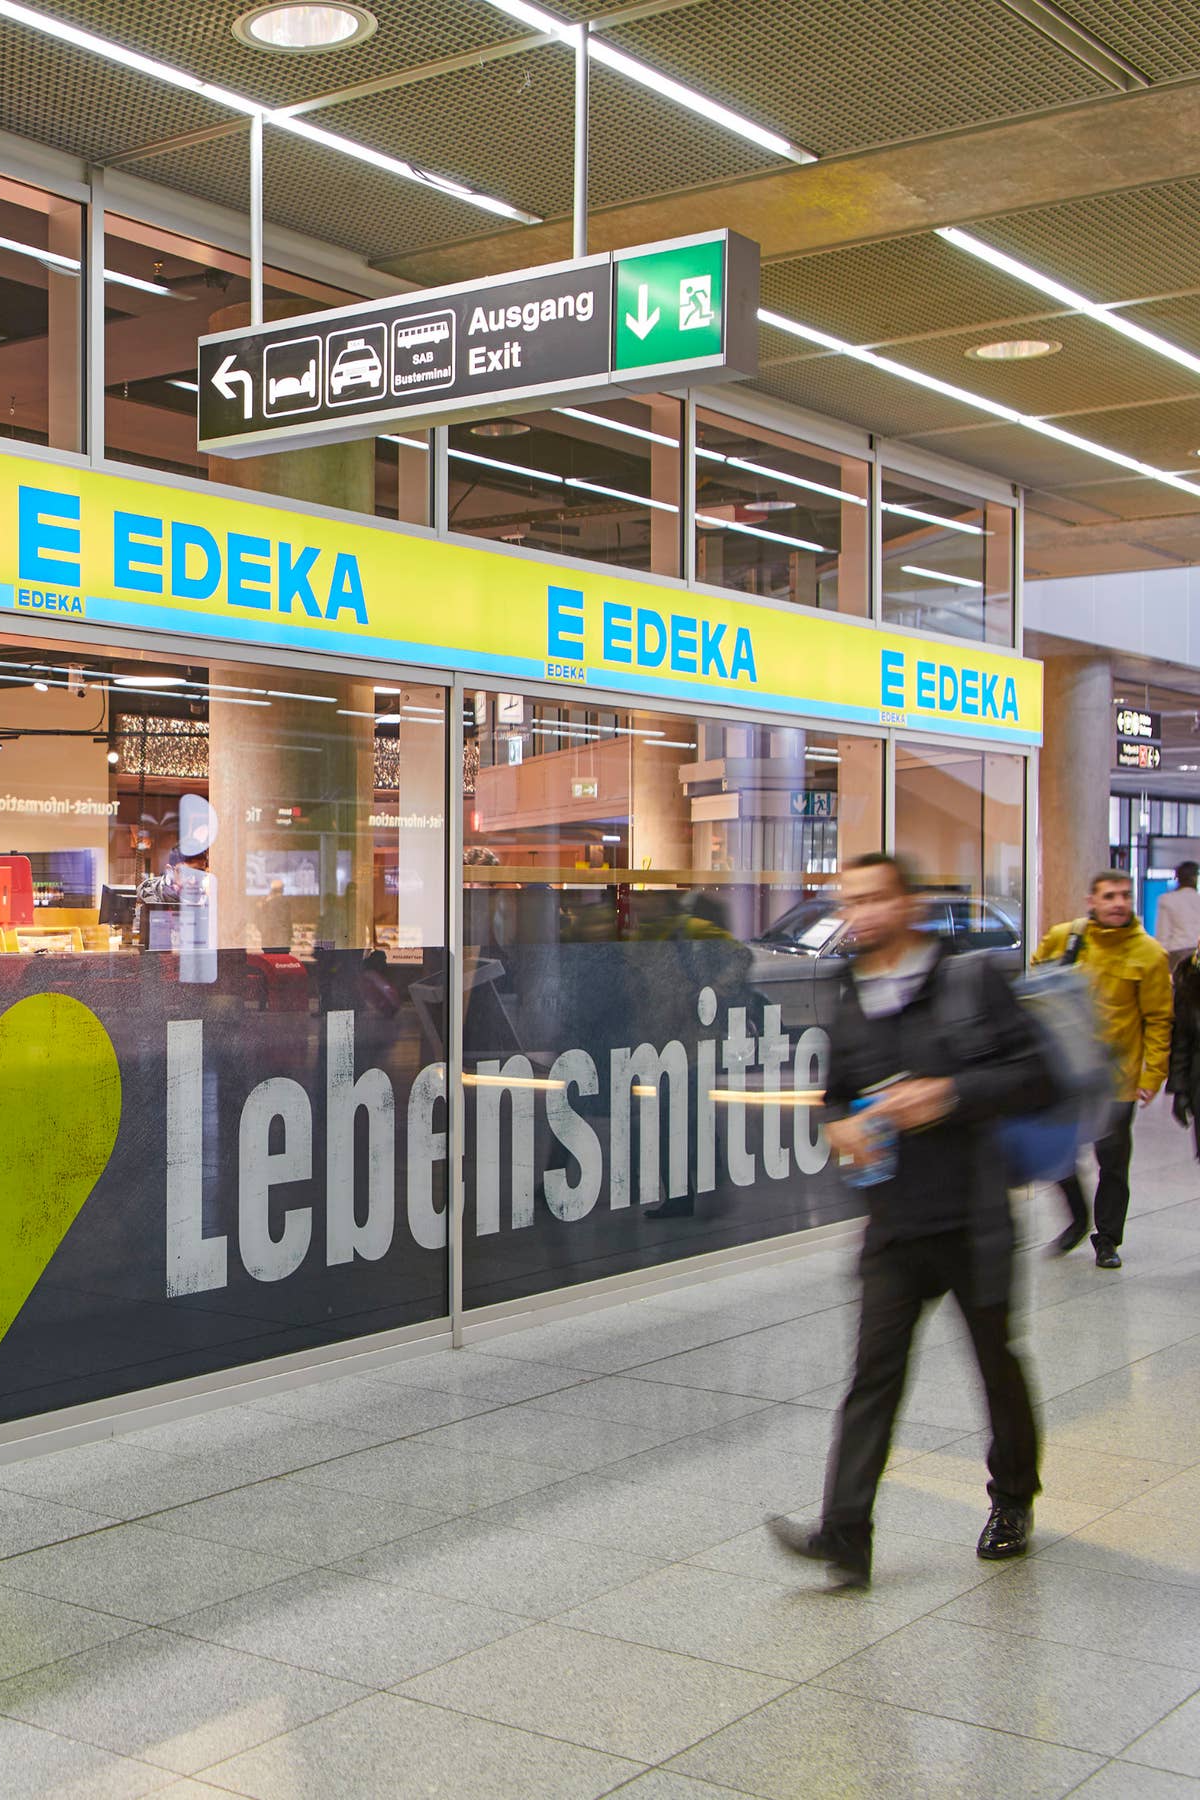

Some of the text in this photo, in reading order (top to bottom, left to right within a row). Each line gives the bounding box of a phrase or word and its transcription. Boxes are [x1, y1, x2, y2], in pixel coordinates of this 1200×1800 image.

[468, 291, 594, 335] Ausgang
[412, 351, 434, 365] SAB
[469, 342, 522, 375] Exit
[394, 365, 452, 387] Busterminal
[19, 486, 369, 624] E EDEKA
[18, 589, 82, 613] EDEKA
[548, 585, 757, 682] E EDEKA
[547, 664, 584, 679] EDEKA
[881, 649, 1019, 721] E EDEKA
[881, 712, 906, 723] EDEKA
[166, 985, 834, 1298] Lebensmitte
